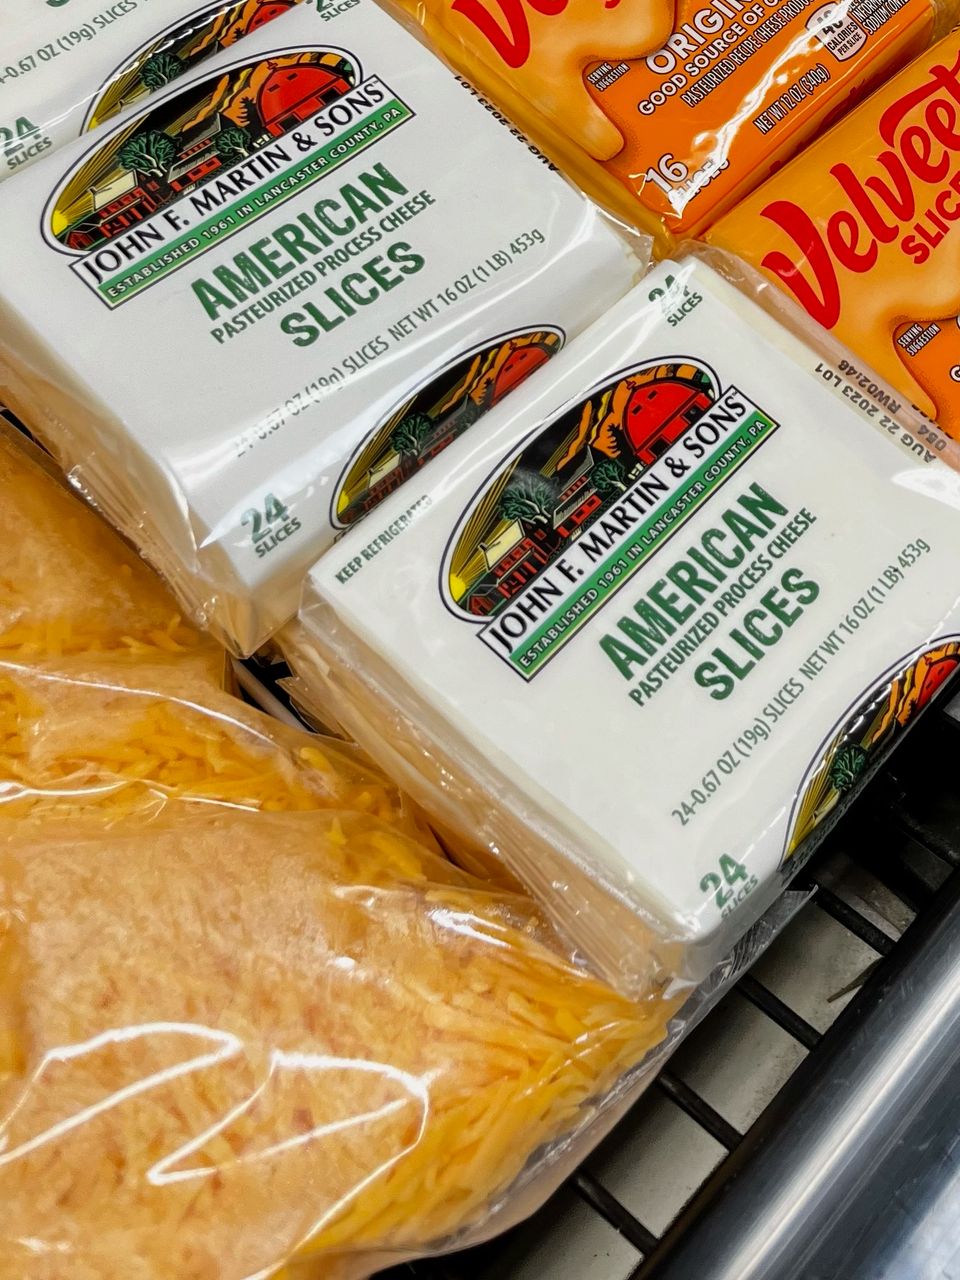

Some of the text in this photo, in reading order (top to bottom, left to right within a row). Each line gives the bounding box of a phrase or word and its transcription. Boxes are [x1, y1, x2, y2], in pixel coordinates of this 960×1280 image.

[82, 82, 385, 286] JOHN F. MARTIN & SONS
[188, 162, 411, 322] AMERICAN
[210, 190, 437, 346] PASTEURIZED PROCESS CHEESE
[278, 240, 428, 350] SLICES
[665, 290, 704, 329] SLICES
[814, 362, 937, 464] AUG 22 2023 L01
[334, 494, 434, 584] KEEP REFRIGERATED
[488, 392, 749, 655] JOHN F. MARTIN & SONS
[518, 420, 768, 668] ESTABLISHED 1961 IN LANCASTER COUNTY, PA
[597, 482, 791, 682] AMERICAN
[628, 506, 819, 708] PASTEURIZED PROCESS CHEESE
[671, 536, 932, 827] 24-0.67 OZ (19g) SLICES NET WT 16 OZ (1 LB) 453g
[692, 567, 824, 704] SLICES
[699, 852, 749, 910] 24
